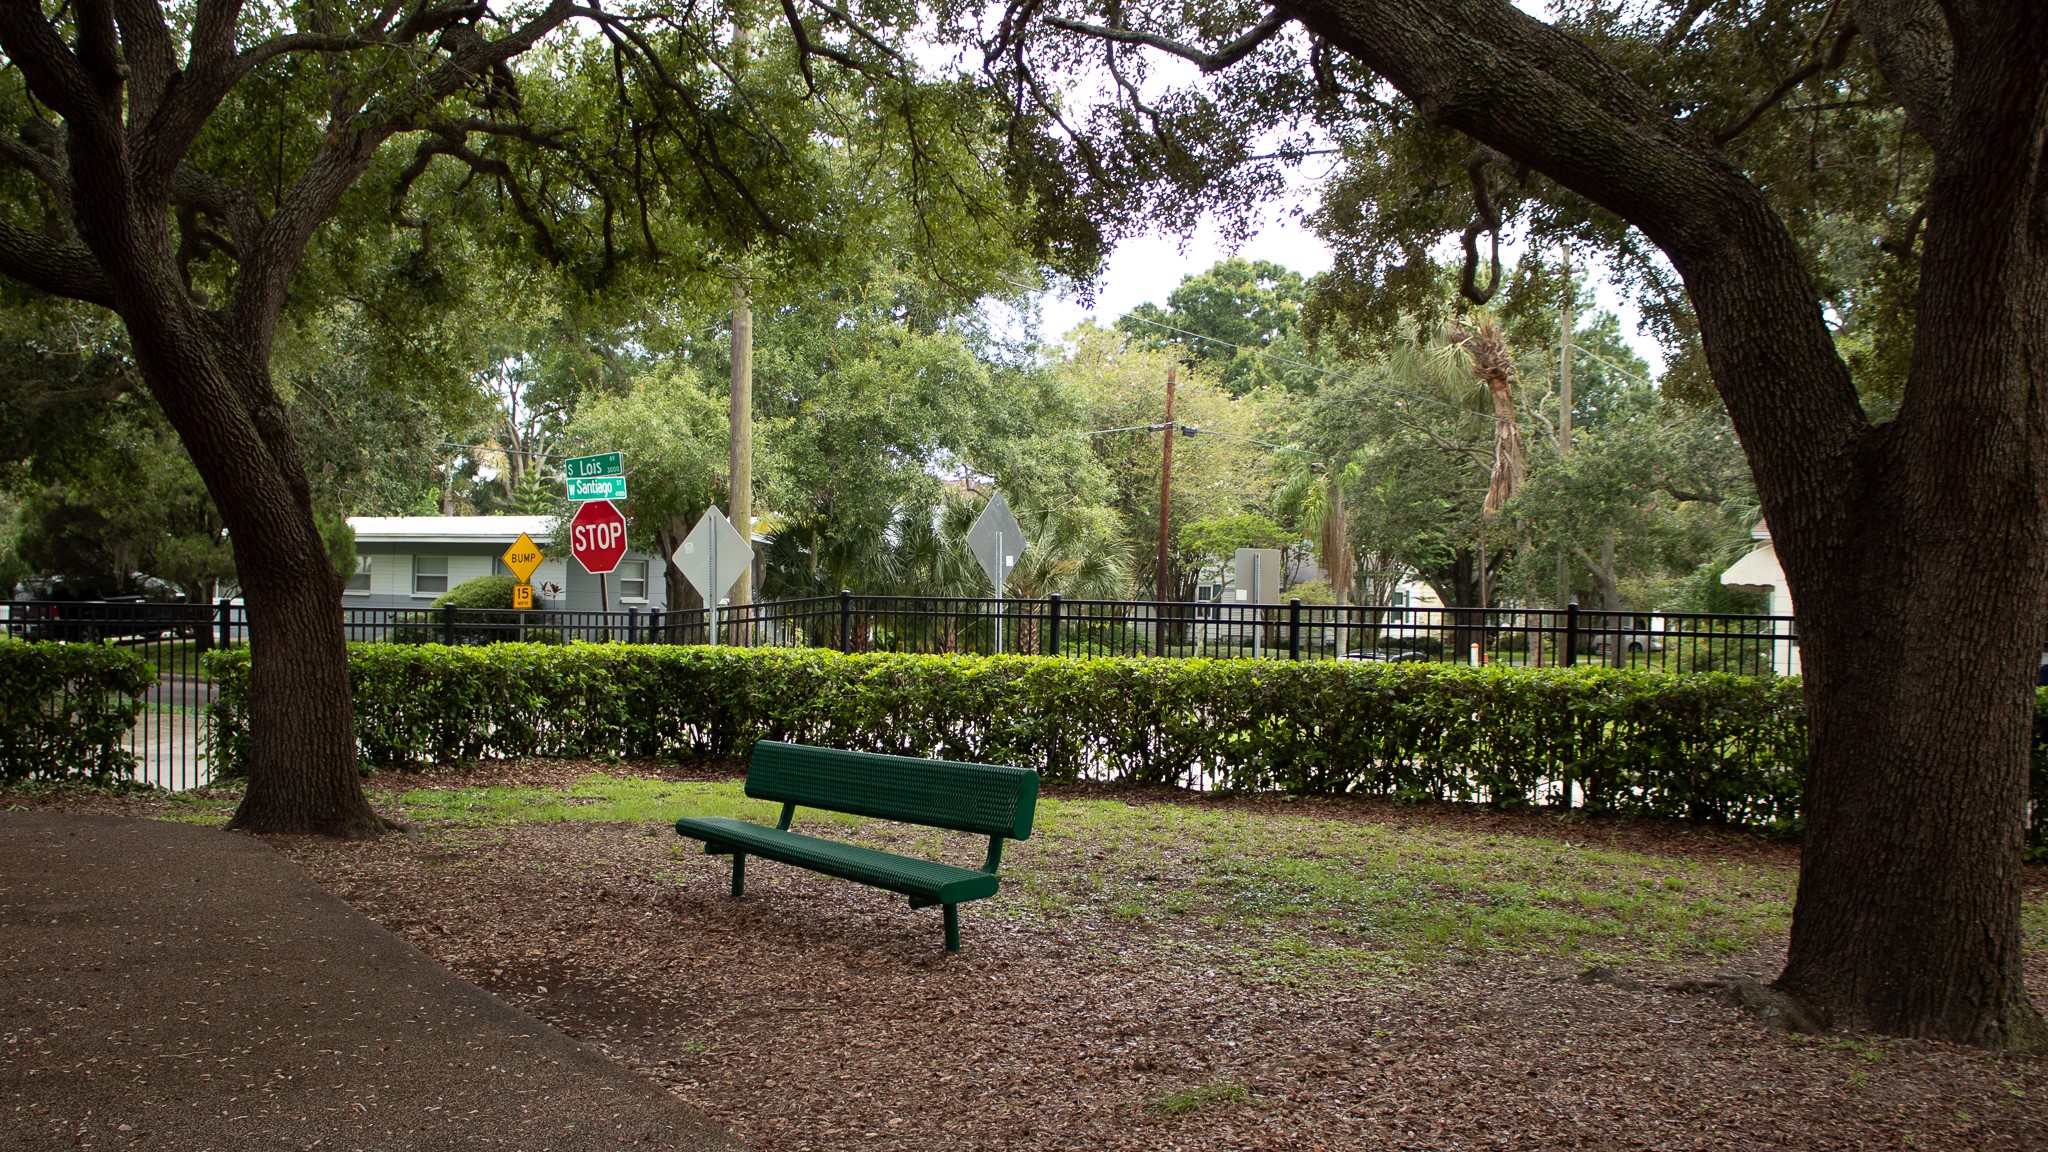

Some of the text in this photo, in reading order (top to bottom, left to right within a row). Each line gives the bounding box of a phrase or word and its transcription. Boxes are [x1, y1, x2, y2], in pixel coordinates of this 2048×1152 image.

[567, 463, 574, 476] S
[579, 458, 602, 476] Lois
[568, 484, 575, 496] W
[576, 479, 613, 498] Santiago
[575, 522, 622, 552] STOP
[511, 553, 536, 563] BUMP
[517, 587, 529, 599] 15
